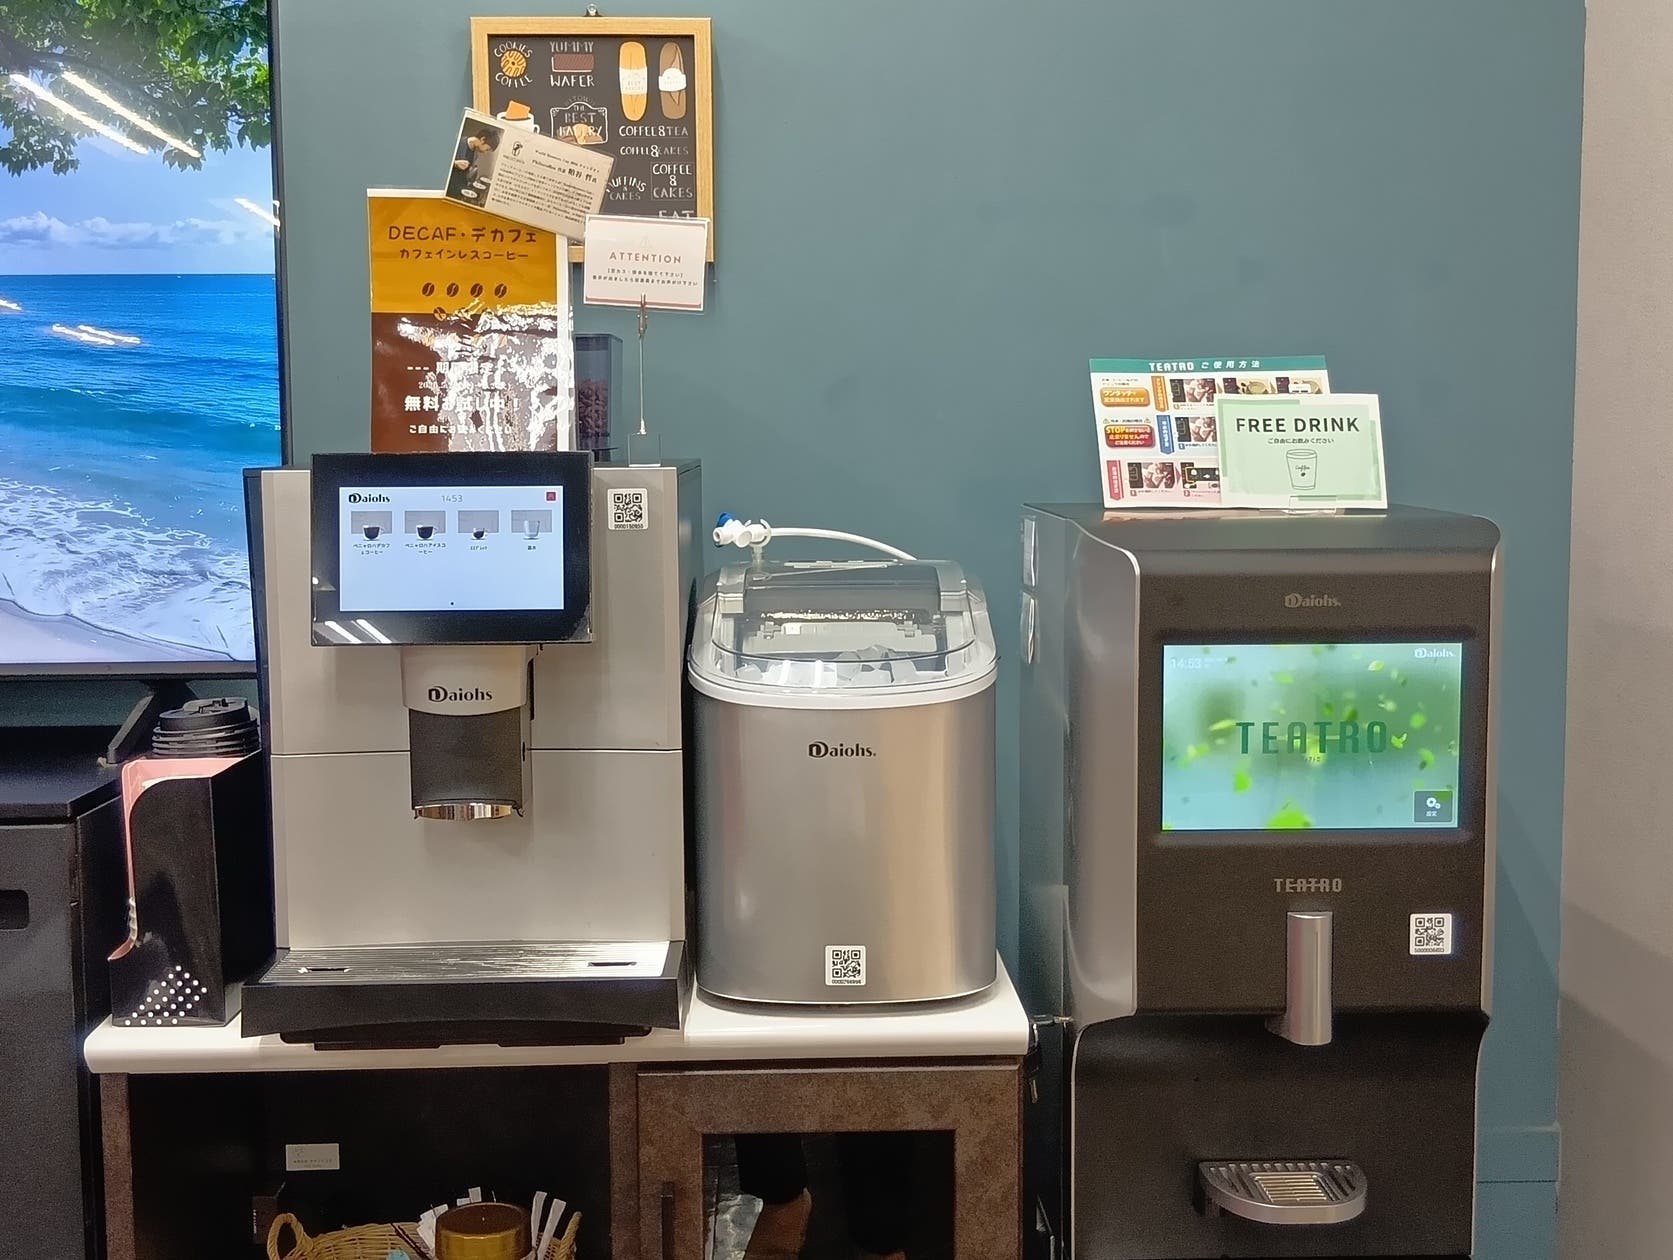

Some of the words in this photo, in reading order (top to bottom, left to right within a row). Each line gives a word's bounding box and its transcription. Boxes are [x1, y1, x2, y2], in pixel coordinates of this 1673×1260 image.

[549, 41, 595, 53] YUMMY
[495, 72, 533, 89] COFFEE
[549, 74, 596, 88] WAFER
[564, 112, 597, 124] BEST
[652, 163, 693, 175] COFFEE
[609, 191, 641, 200] CAKES
[653, 186, 694, 199] CAKES
[399, 248, 529, 261] カフェインレスコーヒー
[608, 251, 682, 264] ATTENTION
[1148, 362, 1195, 372] TEATRO
[1200, 360, 1261, 370] ご使用方法
[1236, 418, 1287, 433] FREE
[1294, 417, 1360, 433] DRINK
[348, 492, 391, 504] Daiohs
[428, 685, 493, 703] Daiohs
[1235, 721, 1388, 755] TEATRO
[808, 741, 877, 759] Daiohs.
[1273, 878, 1343, 893] TEATRO
